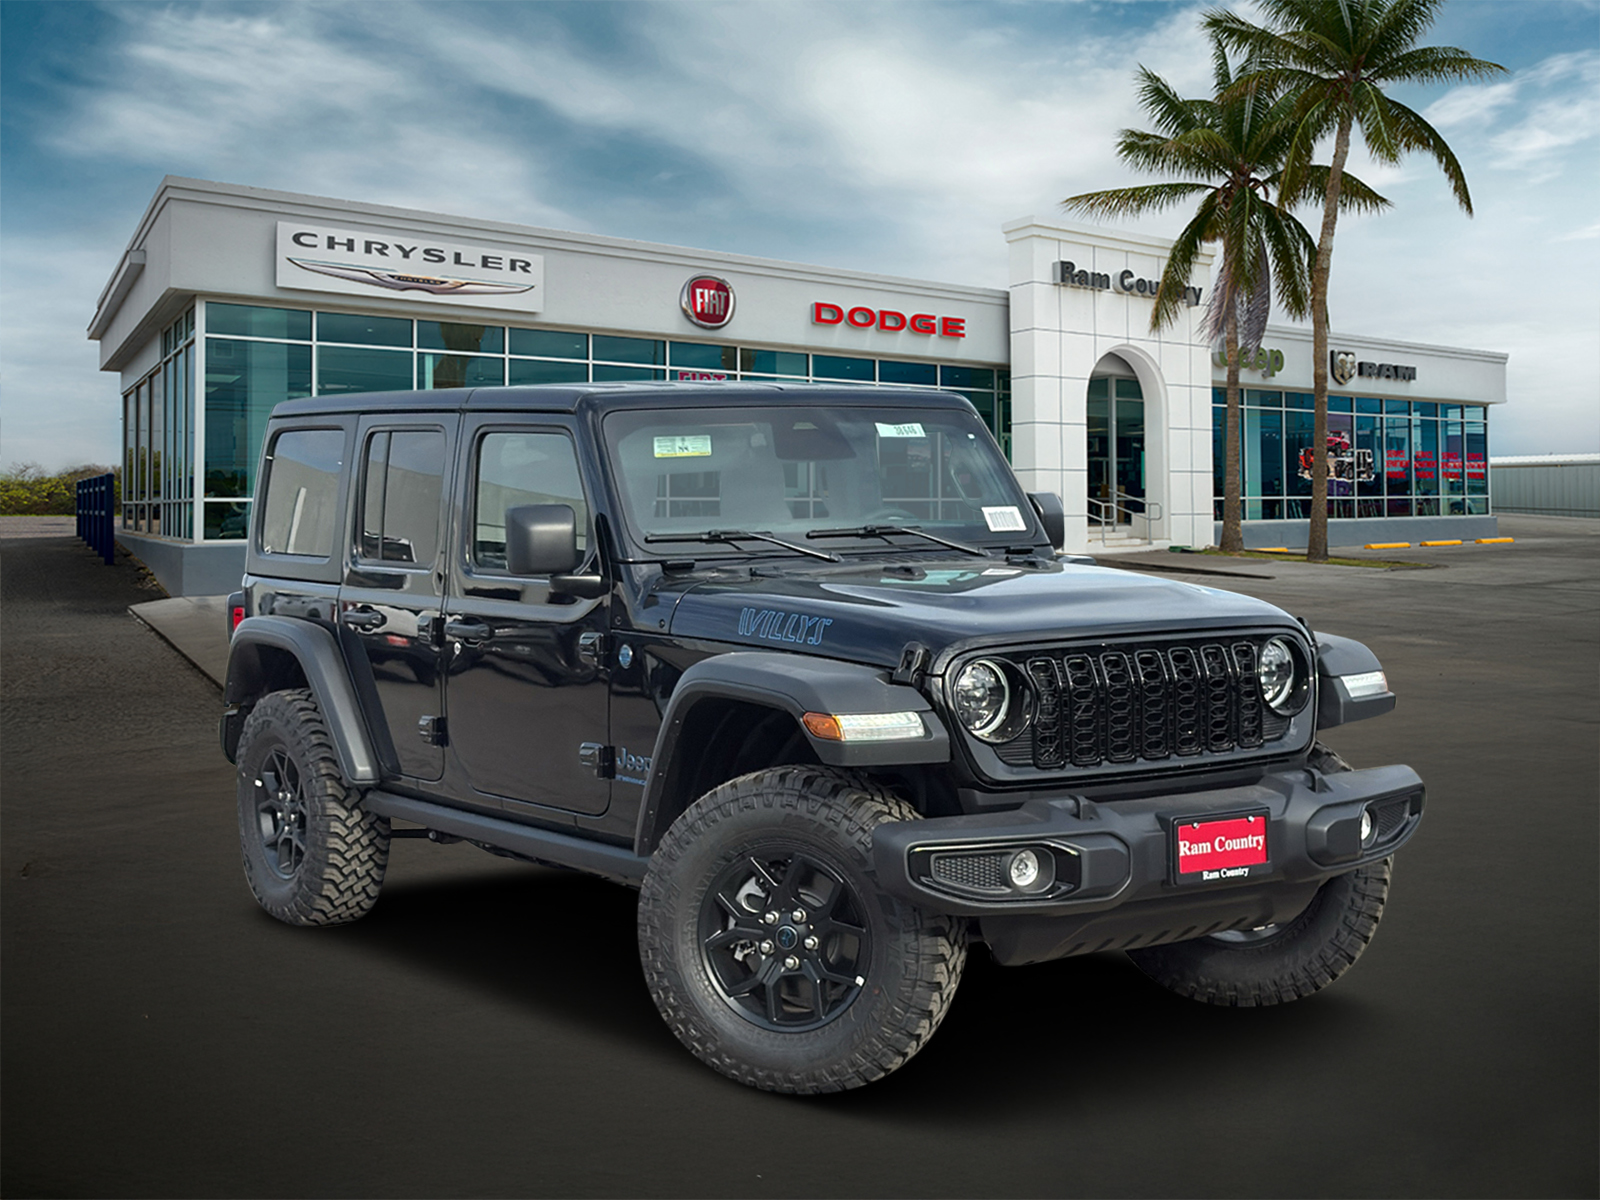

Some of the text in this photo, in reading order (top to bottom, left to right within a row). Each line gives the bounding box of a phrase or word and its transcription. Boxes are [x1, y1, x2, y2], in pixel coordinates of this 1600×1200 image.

[292, 232, 532, 274] CHRYSLER
[1054, 260, 1203, 307] Ram Coury
[695, 287, 728, 316] FIAT
[812, 301, 966, 339] DODGE
[1358, 361, 1416, 381] RAM
[739, 607, 833, 646] WILLYS
[1179, 833, 1265, 857] Ram Country
[1203, 867, 1249, 880] Ram Country
